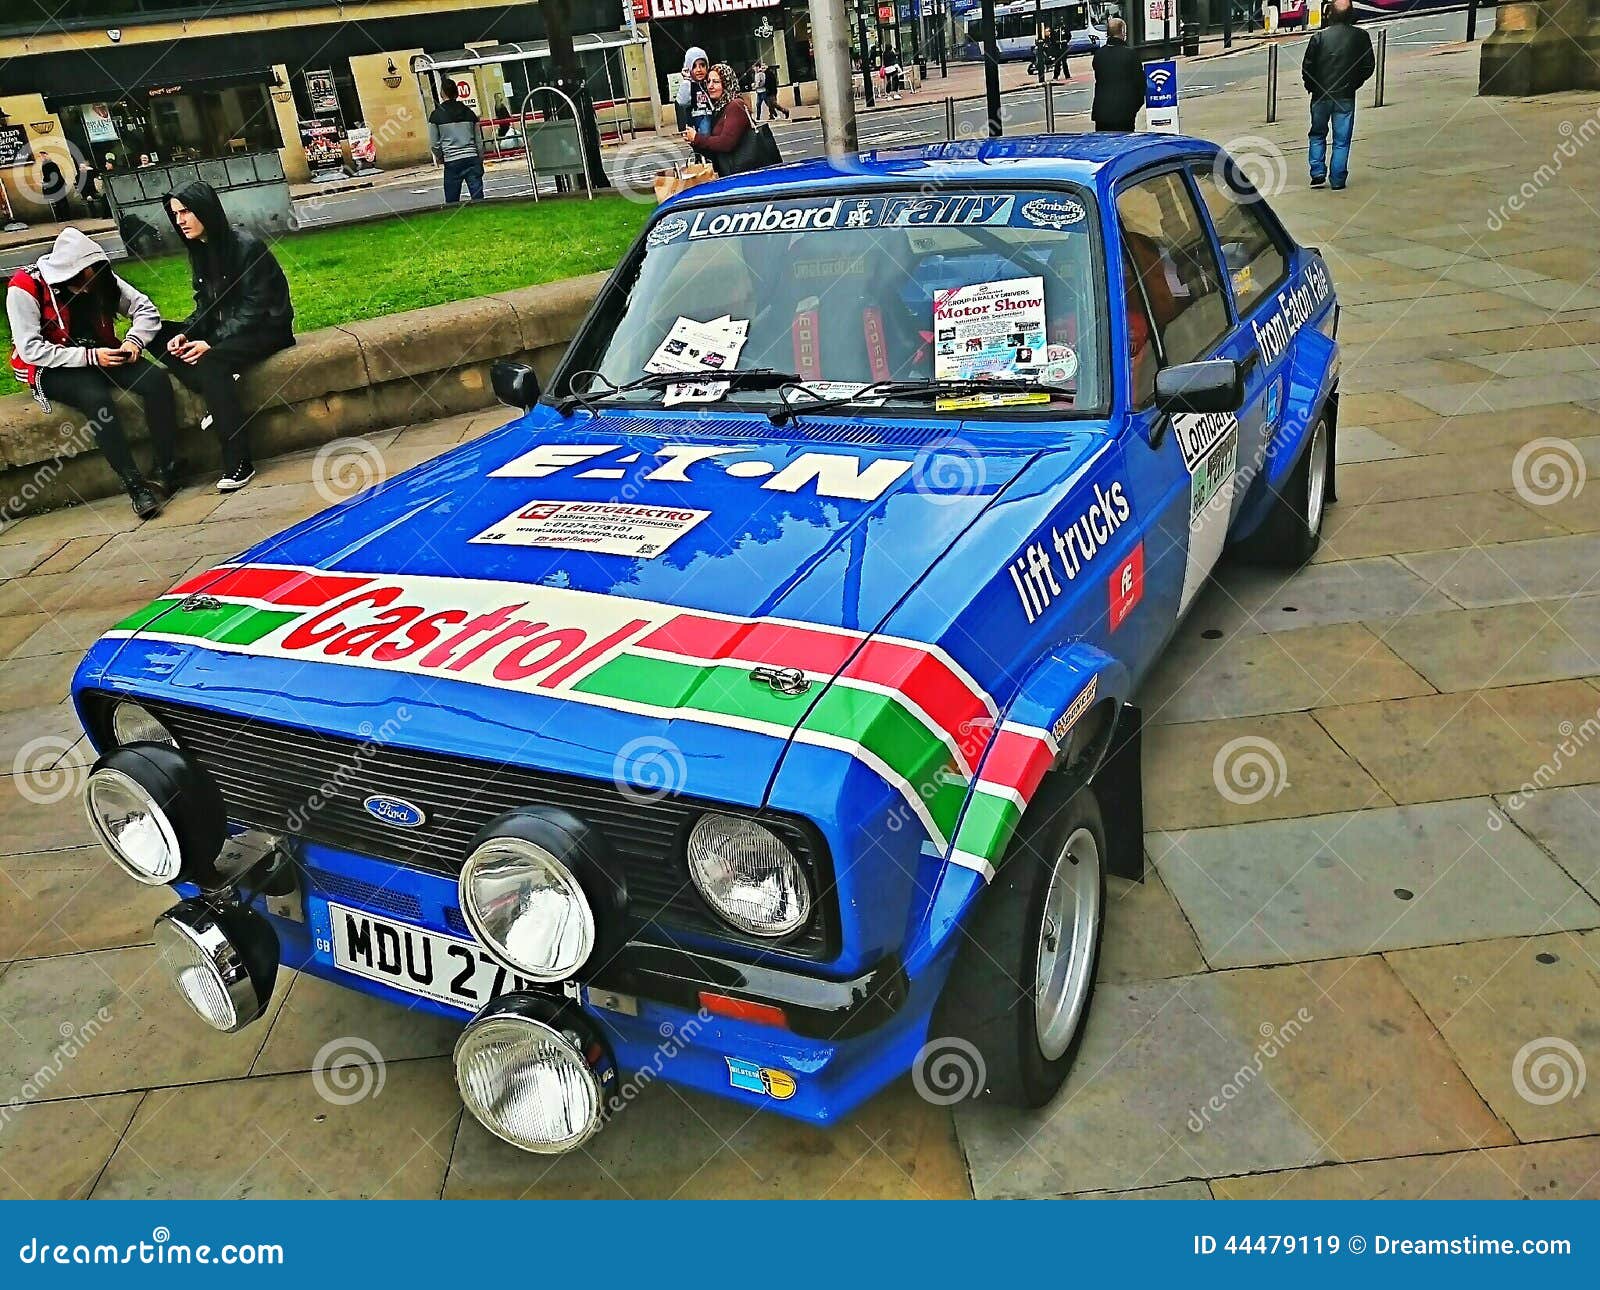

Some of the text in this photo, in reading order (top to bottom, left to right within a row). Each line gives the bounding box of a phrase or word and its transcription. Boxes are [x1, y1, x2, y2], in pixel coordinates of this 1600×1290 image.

[688, 199, 842, 237] Lombard
[883, 196, 1011, 225] rally
[1029, 200, 1081, 212] Lombard
[937, 298, 1042, 320] Motor Show
[1252, 261, 1329, 367] from Eaton Yale
[565, 504, 695, 521] AUTOELECTRO
[516, 527, 646, 542] www.autoelectro.co.uk
[1008, 481, 1130, 624] lift trucks
[280, 586, 652, 690] Castrol
[377, 801, 410, 821] Ford
[316, 913, 524, 1003] GB MDU 27
